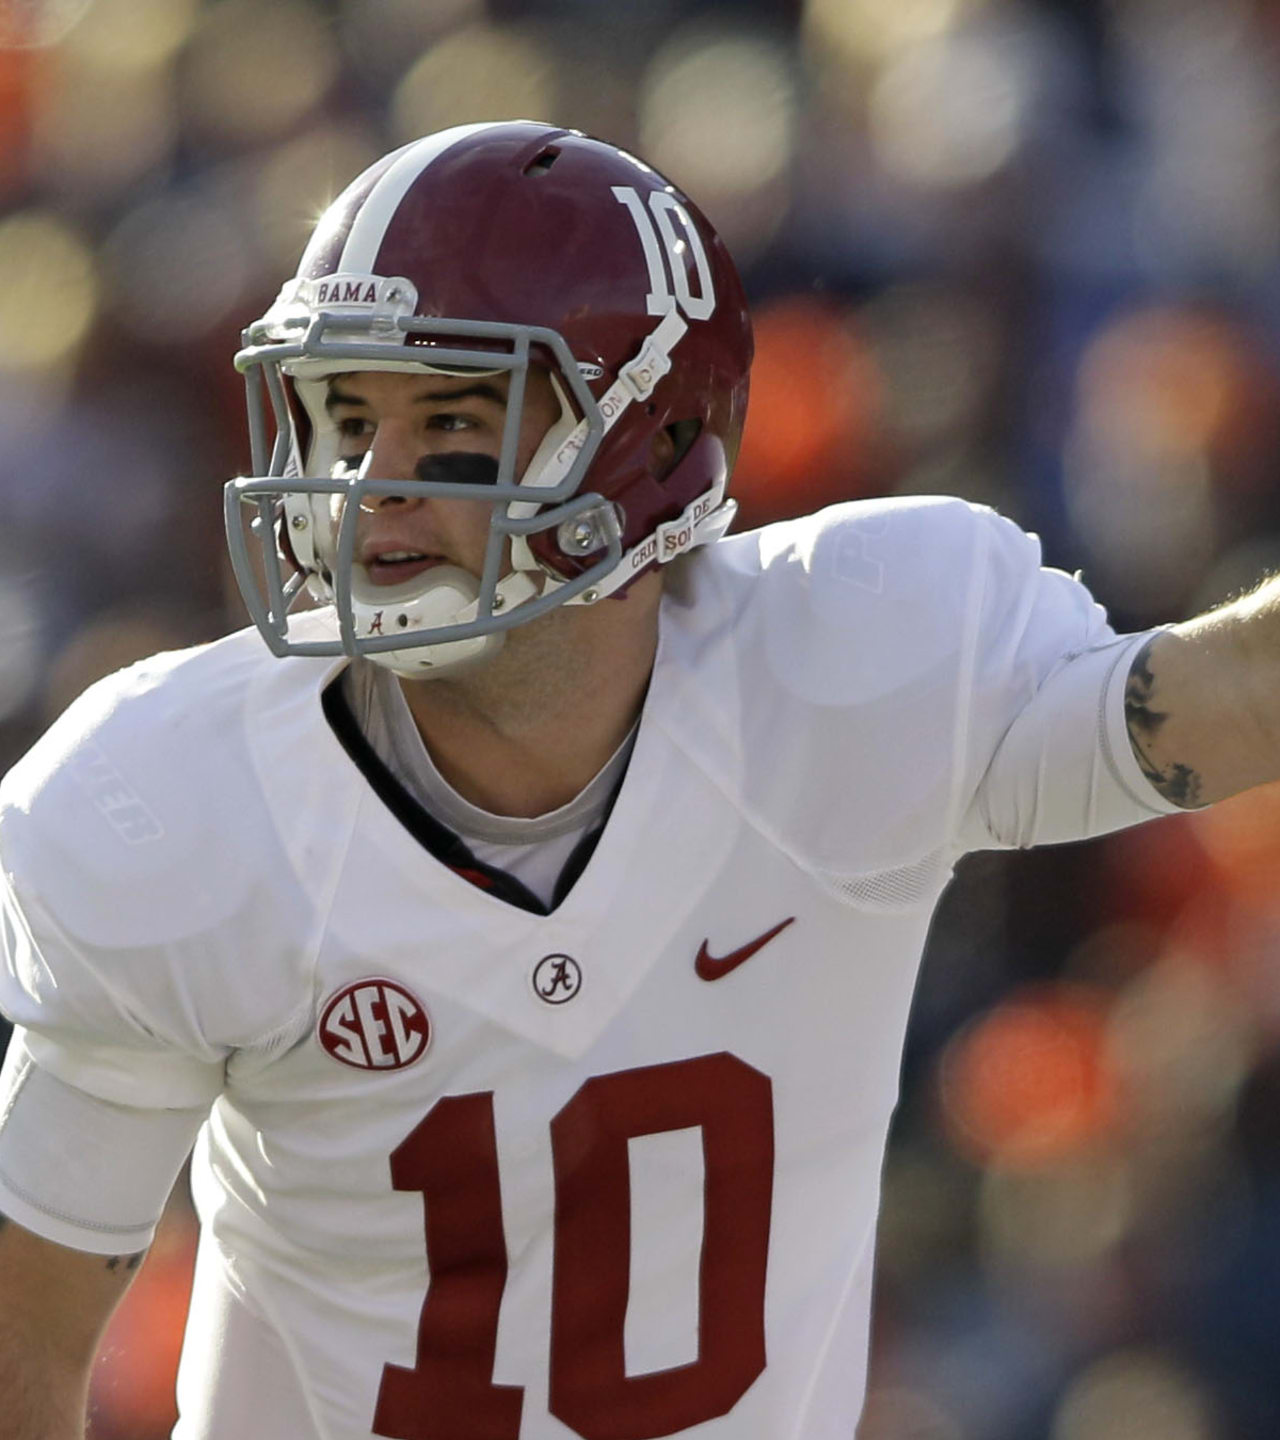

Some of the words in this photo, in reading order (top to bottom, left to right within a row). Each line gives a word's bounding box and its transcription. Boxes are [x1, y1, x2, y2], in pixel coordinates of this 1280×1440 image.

[609, 185, 716, 322] 10
[318, 280, 377, 304] BAMA
[540, 958, 575, 998] A
[325, 985, 423, 1067] SEC
